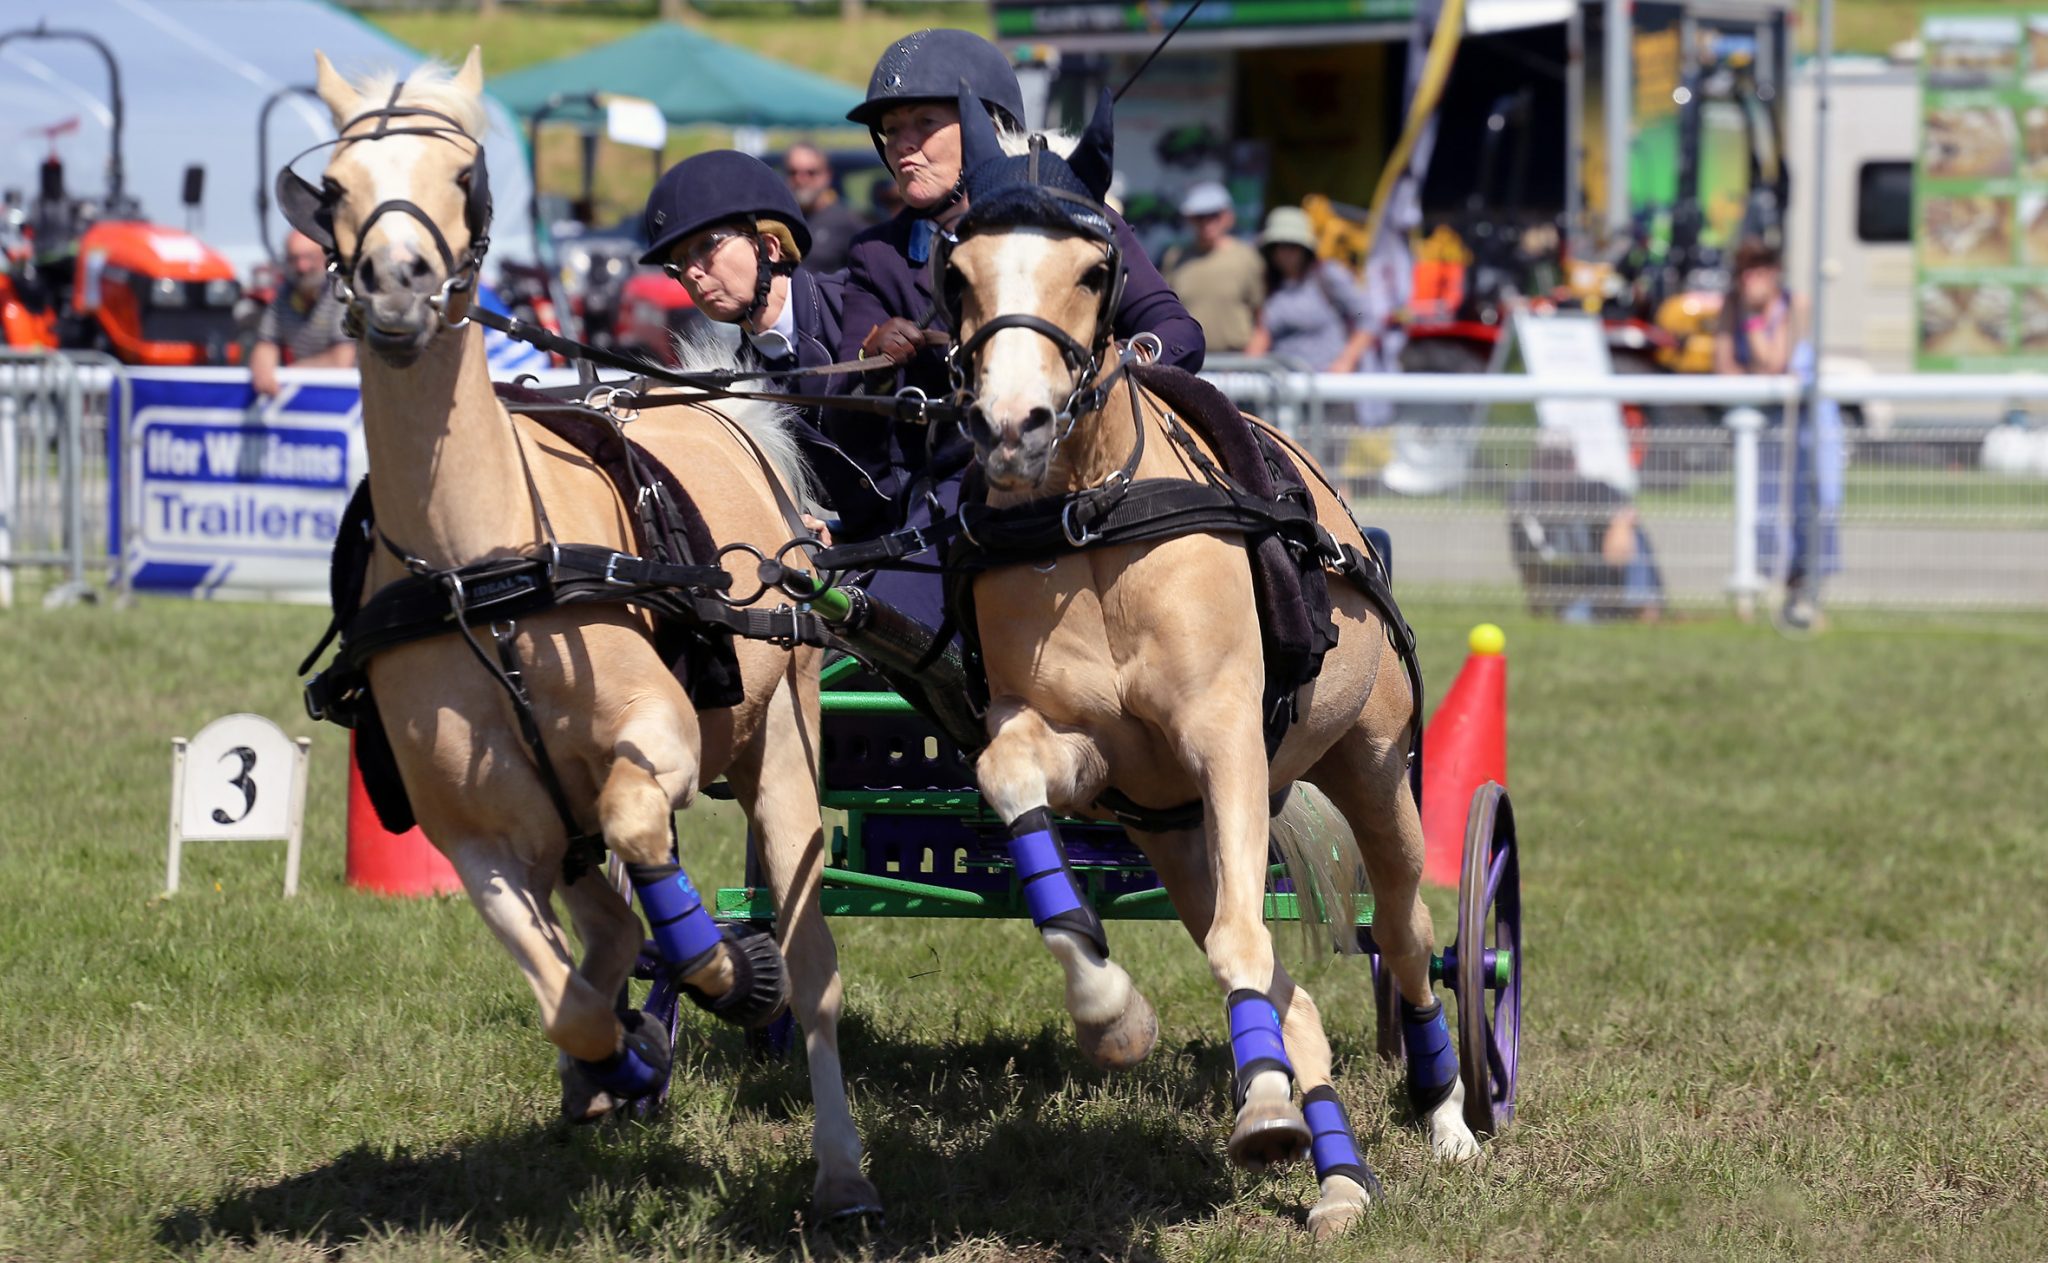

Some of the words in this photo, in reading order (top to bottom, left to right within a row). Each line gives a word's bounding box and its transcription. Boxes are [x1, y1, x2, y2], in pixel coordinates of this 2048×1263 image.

[148, 429, 201, 476] Ifor
[154, 493, 338, 540] Trailers
[473, 577, 514, 598] IDEAL
[211, 745, 257, 825] 3
